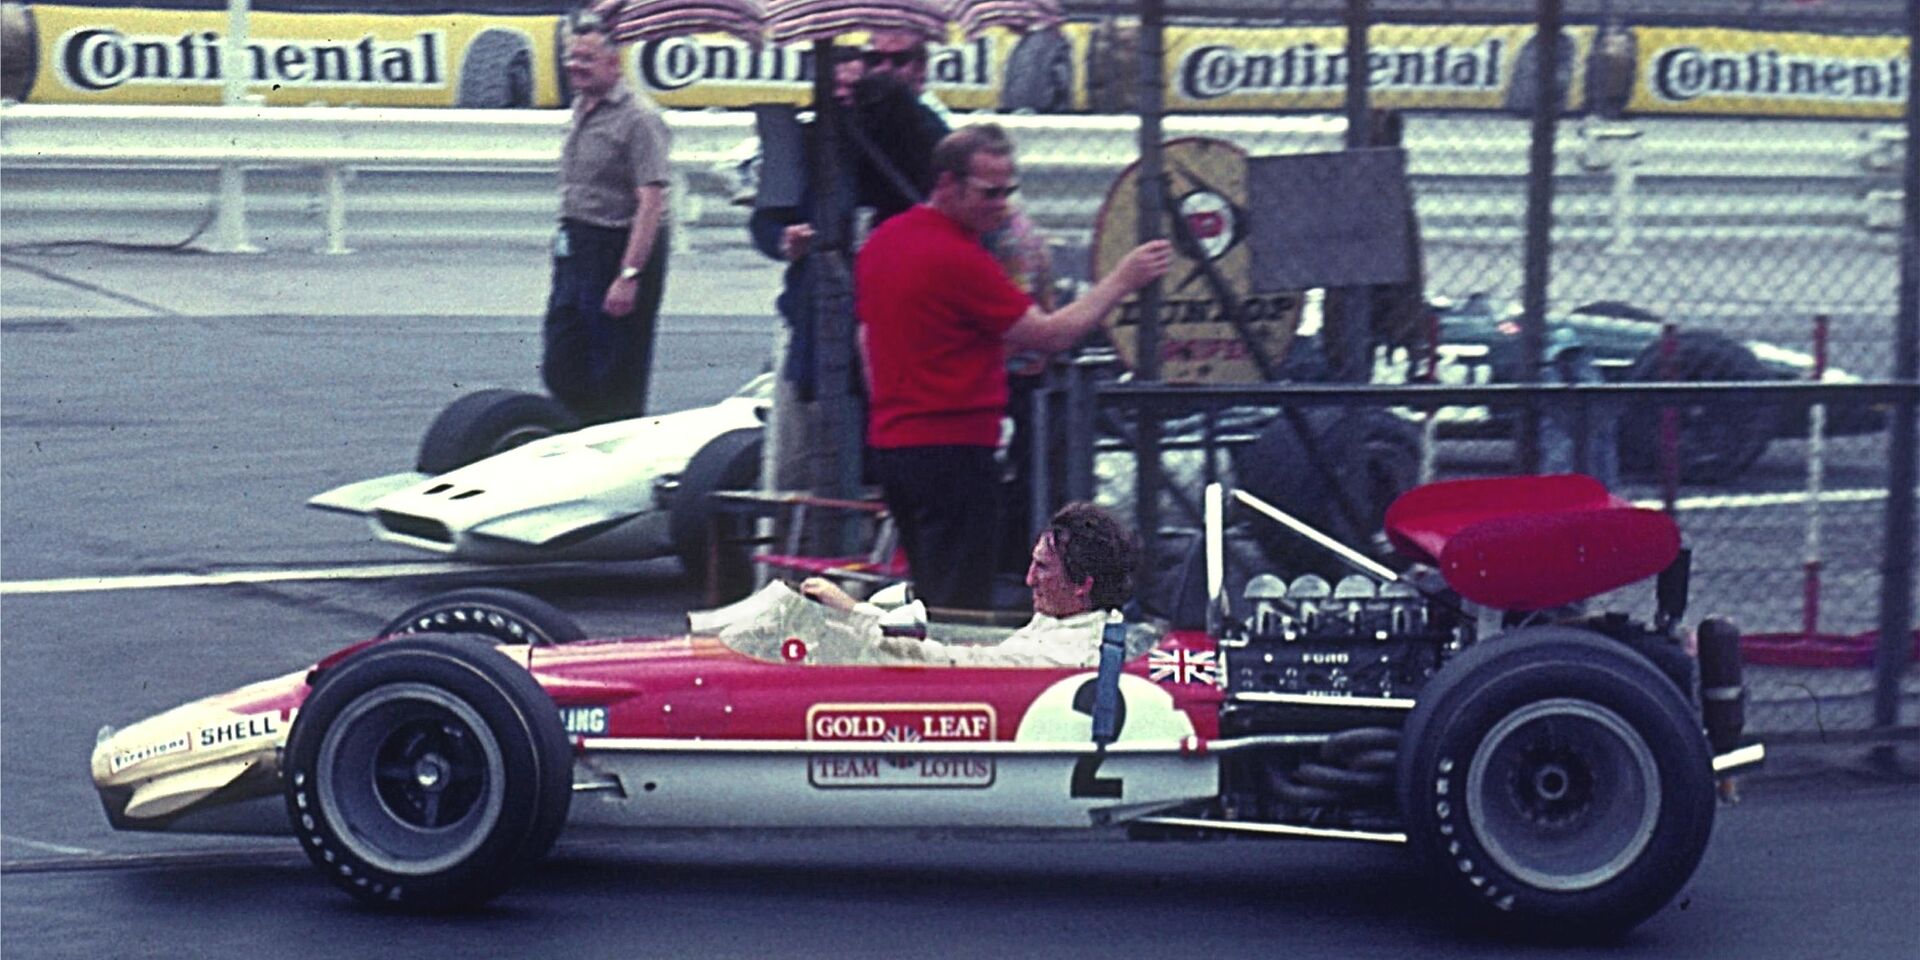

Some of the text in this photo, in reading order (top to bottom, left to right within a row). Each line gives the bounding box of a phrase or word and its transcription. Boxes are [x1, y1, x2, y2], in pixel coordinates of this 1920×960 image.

[201, 716, 278, 747] SHELL
[815, 715, 988, 738] GOLD LEAF
[1070, 675, 1127, 799] 2
[817, 757, 988, 778] TEAM LOTUS
